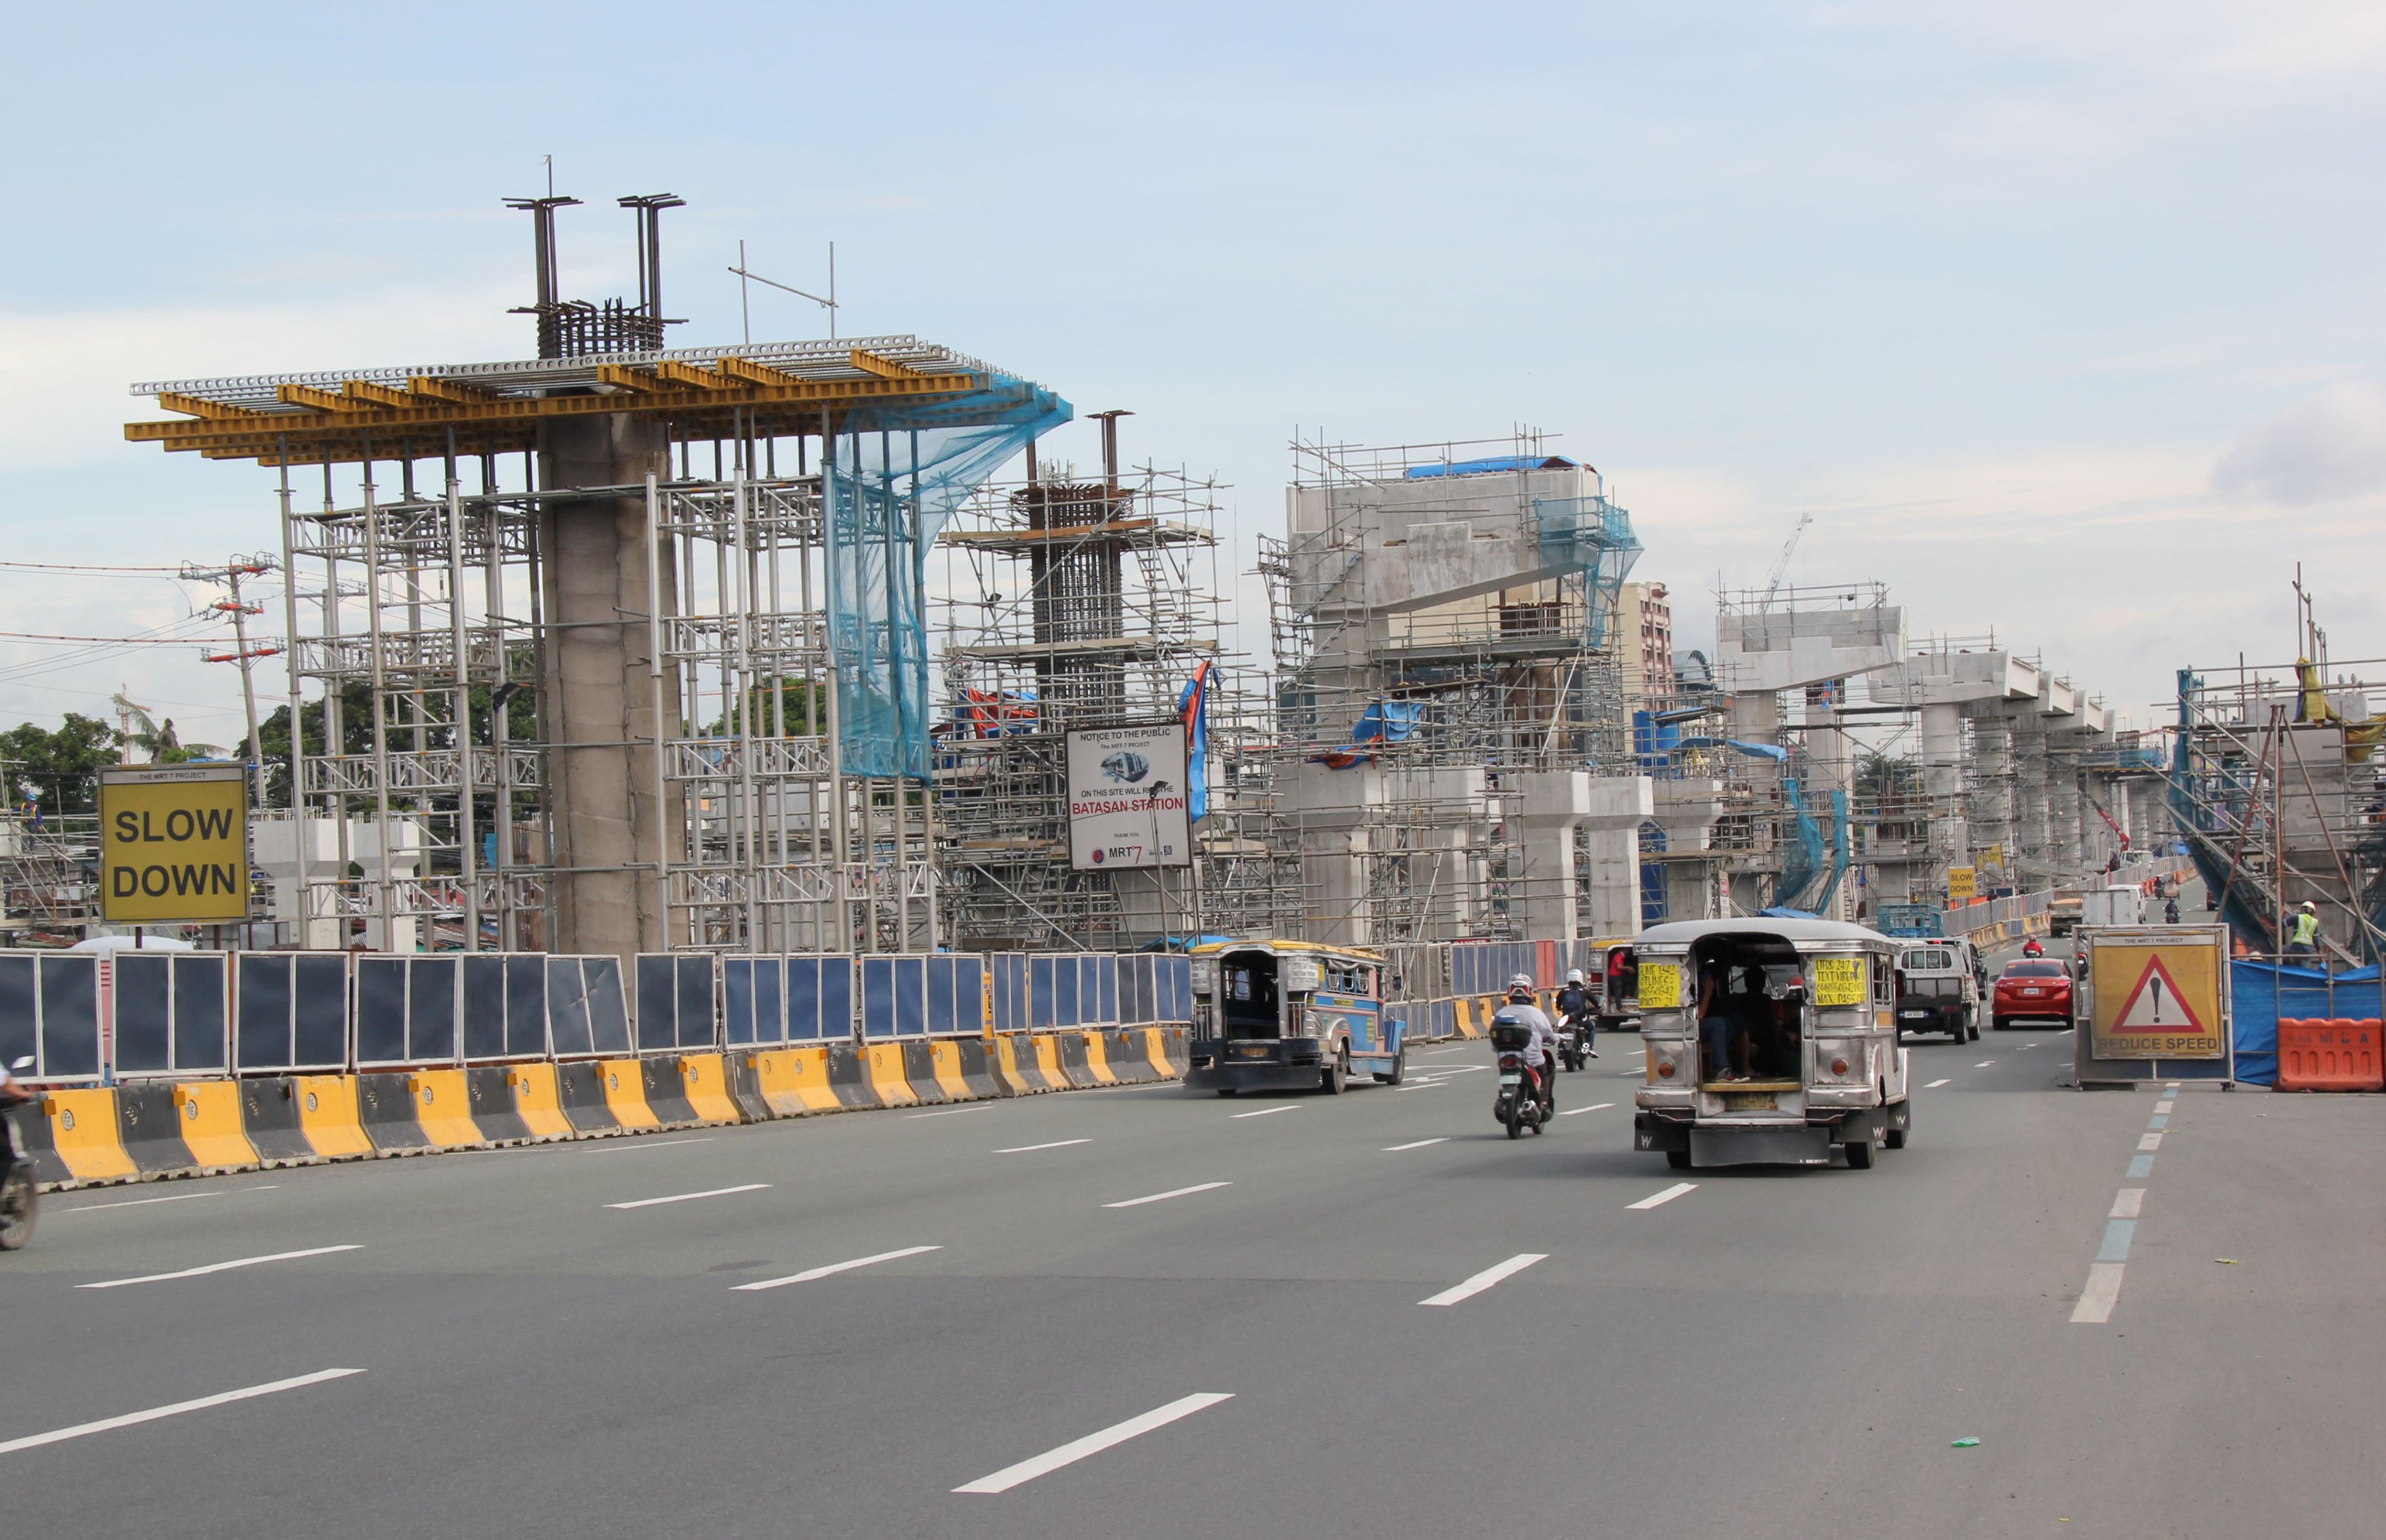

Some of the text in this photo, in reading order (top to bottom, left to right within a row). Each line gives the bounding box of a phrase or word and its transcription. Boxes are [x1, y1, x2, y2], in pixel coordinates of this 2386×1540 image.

[1081, 732, 1110, 741] NOTICE
[1141, 729, 1171, 737] PUBLIC
[1072, 798, 1183, 814] BATASAN STATION
[115, 809, 233, 843] SLOW
[114, 863, 235, 898] DOWN
[2098, 1038, 2218, 1050] REDUCE SPEED
